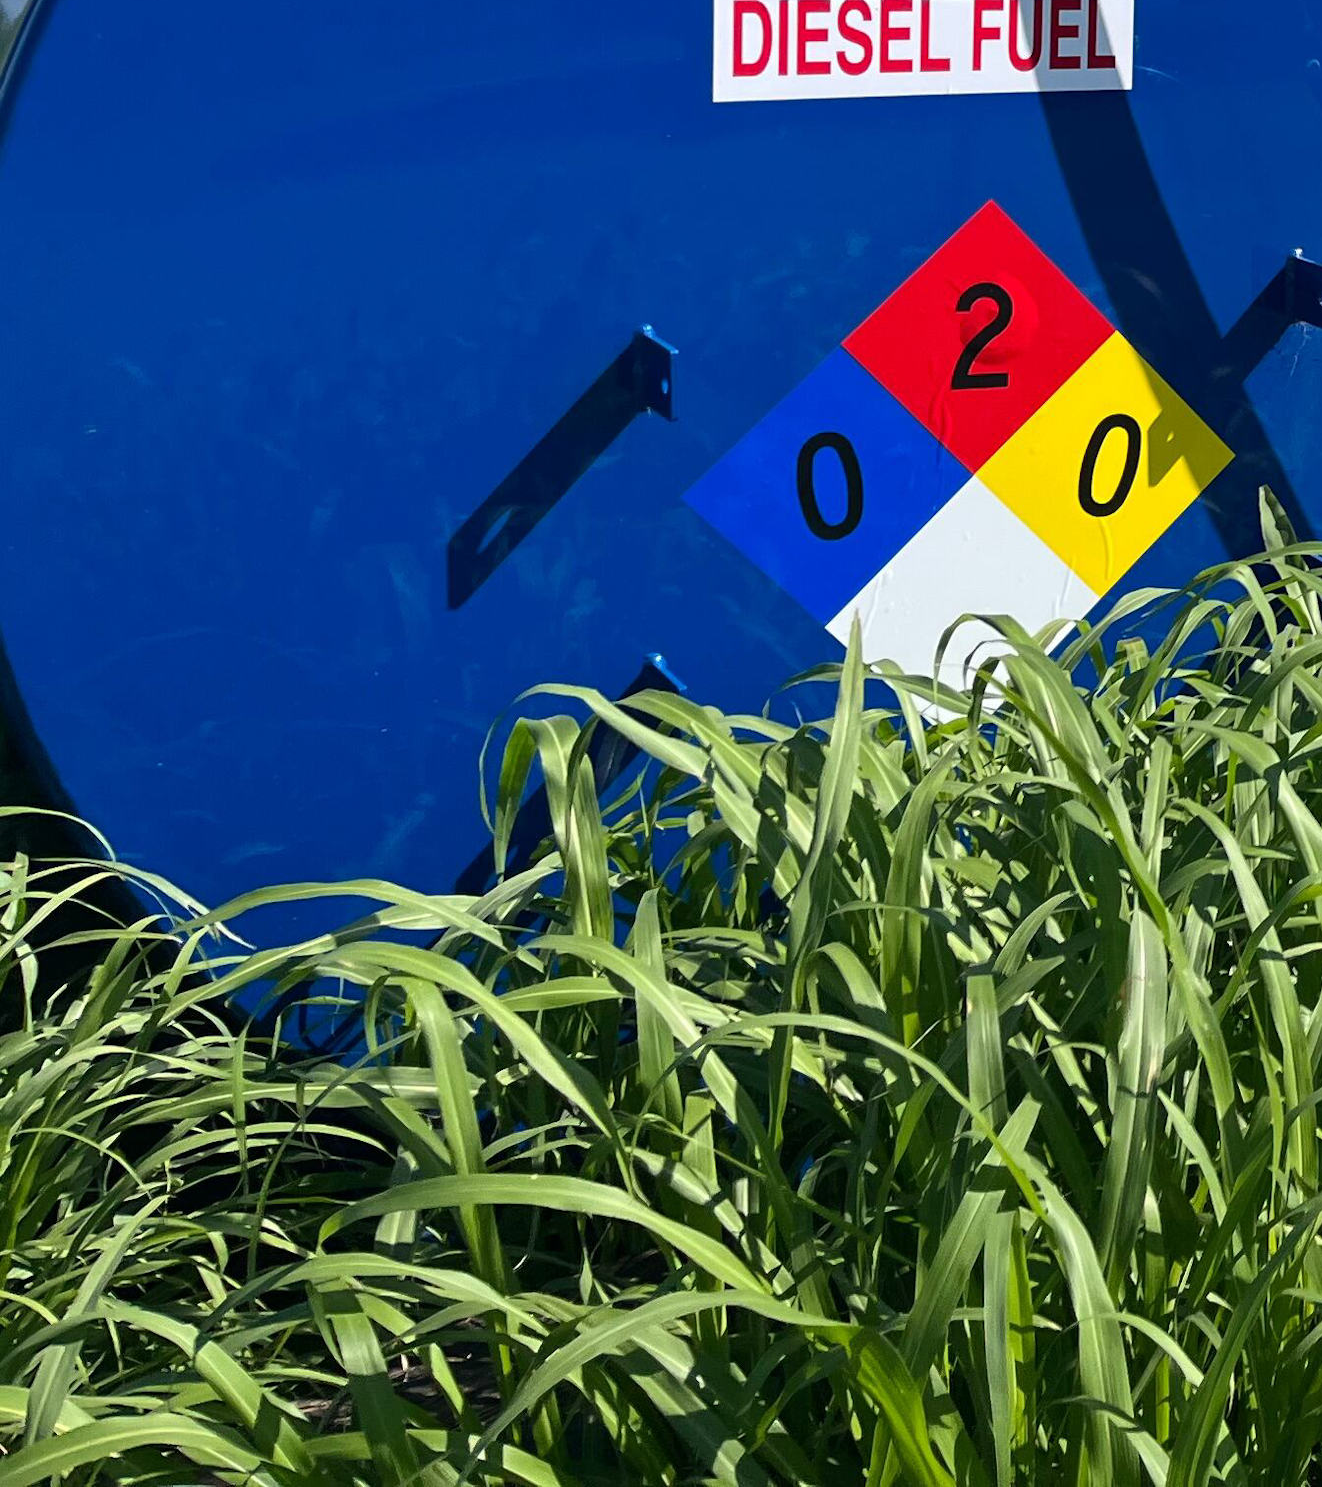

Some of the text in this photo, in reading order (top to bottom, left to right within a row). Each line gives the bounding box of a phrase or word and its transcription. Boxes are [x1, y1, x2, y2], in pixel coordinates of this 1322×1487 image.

[949, 282, 1014, 390] 2
[796, 430, 865, 541] 0
[1078, 413, 1142, 517] 0
